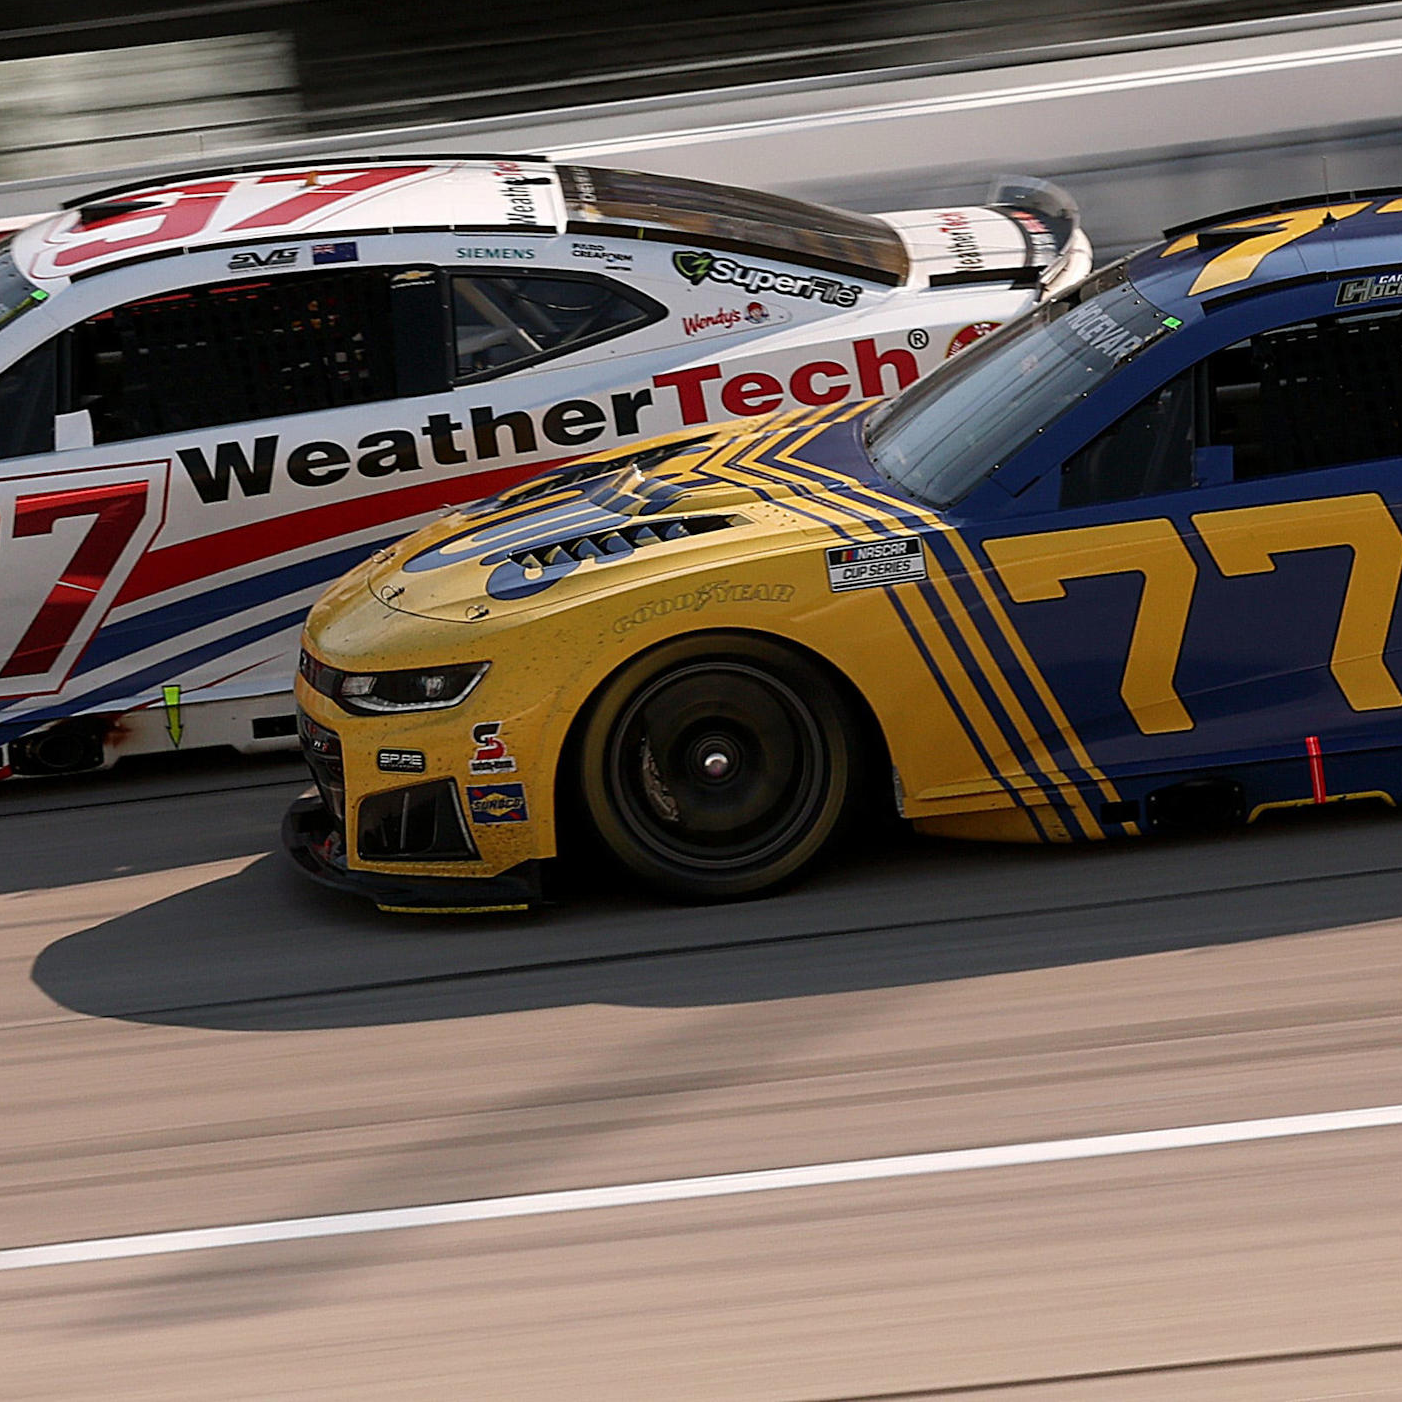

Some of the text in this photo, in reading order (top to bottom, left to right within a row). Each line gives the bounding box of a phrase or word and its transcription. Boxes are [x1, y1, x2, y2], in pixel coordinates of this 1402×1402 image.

[53, 166, 434, 266] 97
[229, 248, 301, 269] SVG
[456, 248, 536, 259] SIEMENS
[708, 259, 858, 307] SuperFile
[683, 308, 741, 336] Wendy's
[1065, 300, 1142, 363] HOCEVAR
[856, 542, 908, 560] NASCAR
[842, 560, 911, 579] CUP SERIES
[613, 582, 796, 634] GOODYEAR
[471, 798, 524, 812] SUNOCO
